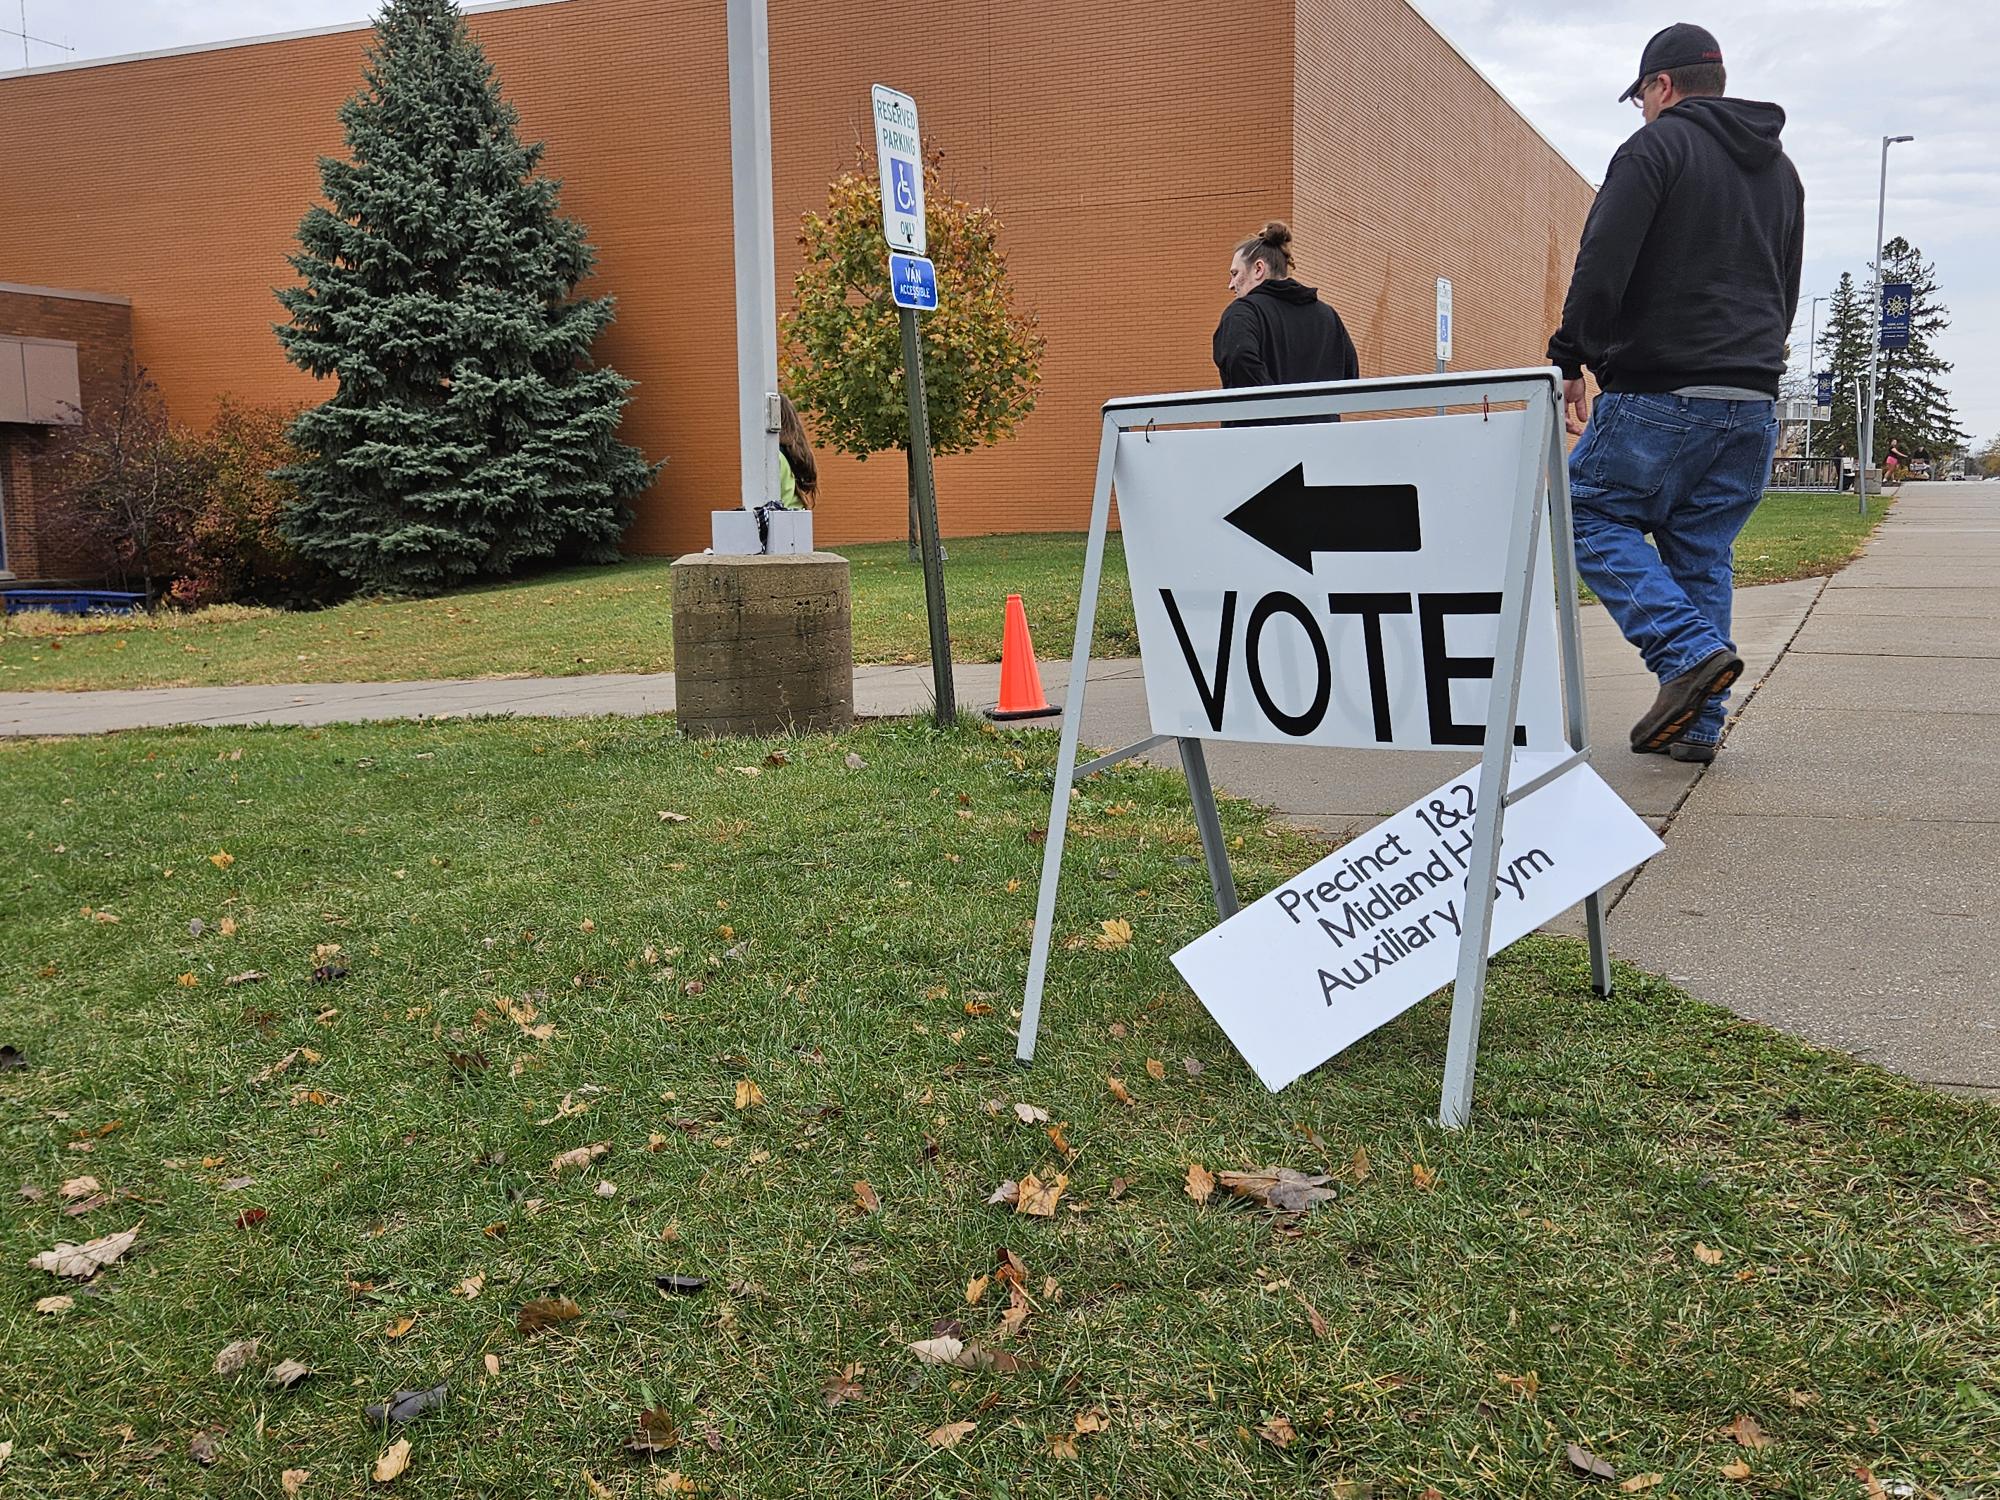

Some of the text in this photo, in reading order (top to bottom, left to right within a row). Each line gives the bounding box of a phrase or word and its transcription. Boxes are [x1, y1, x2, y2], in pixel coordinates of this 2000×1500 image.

[876, 99, 916, 130] RESERVED
[882, 127, 916, 156] PARKING
[900, 221, 915, 236] ONLY
[905, 267, 922, 284] VAN
[900, 284, 931, 299] ACCESSIBLE
[1159, 588, 1527, 746] VOTE
[1275, 784, 1478, 924] Precinct 1&2
[1317, 848, 1454, 948] Midland
[1316, 848, 1555, 1007] Auxiliary ym
